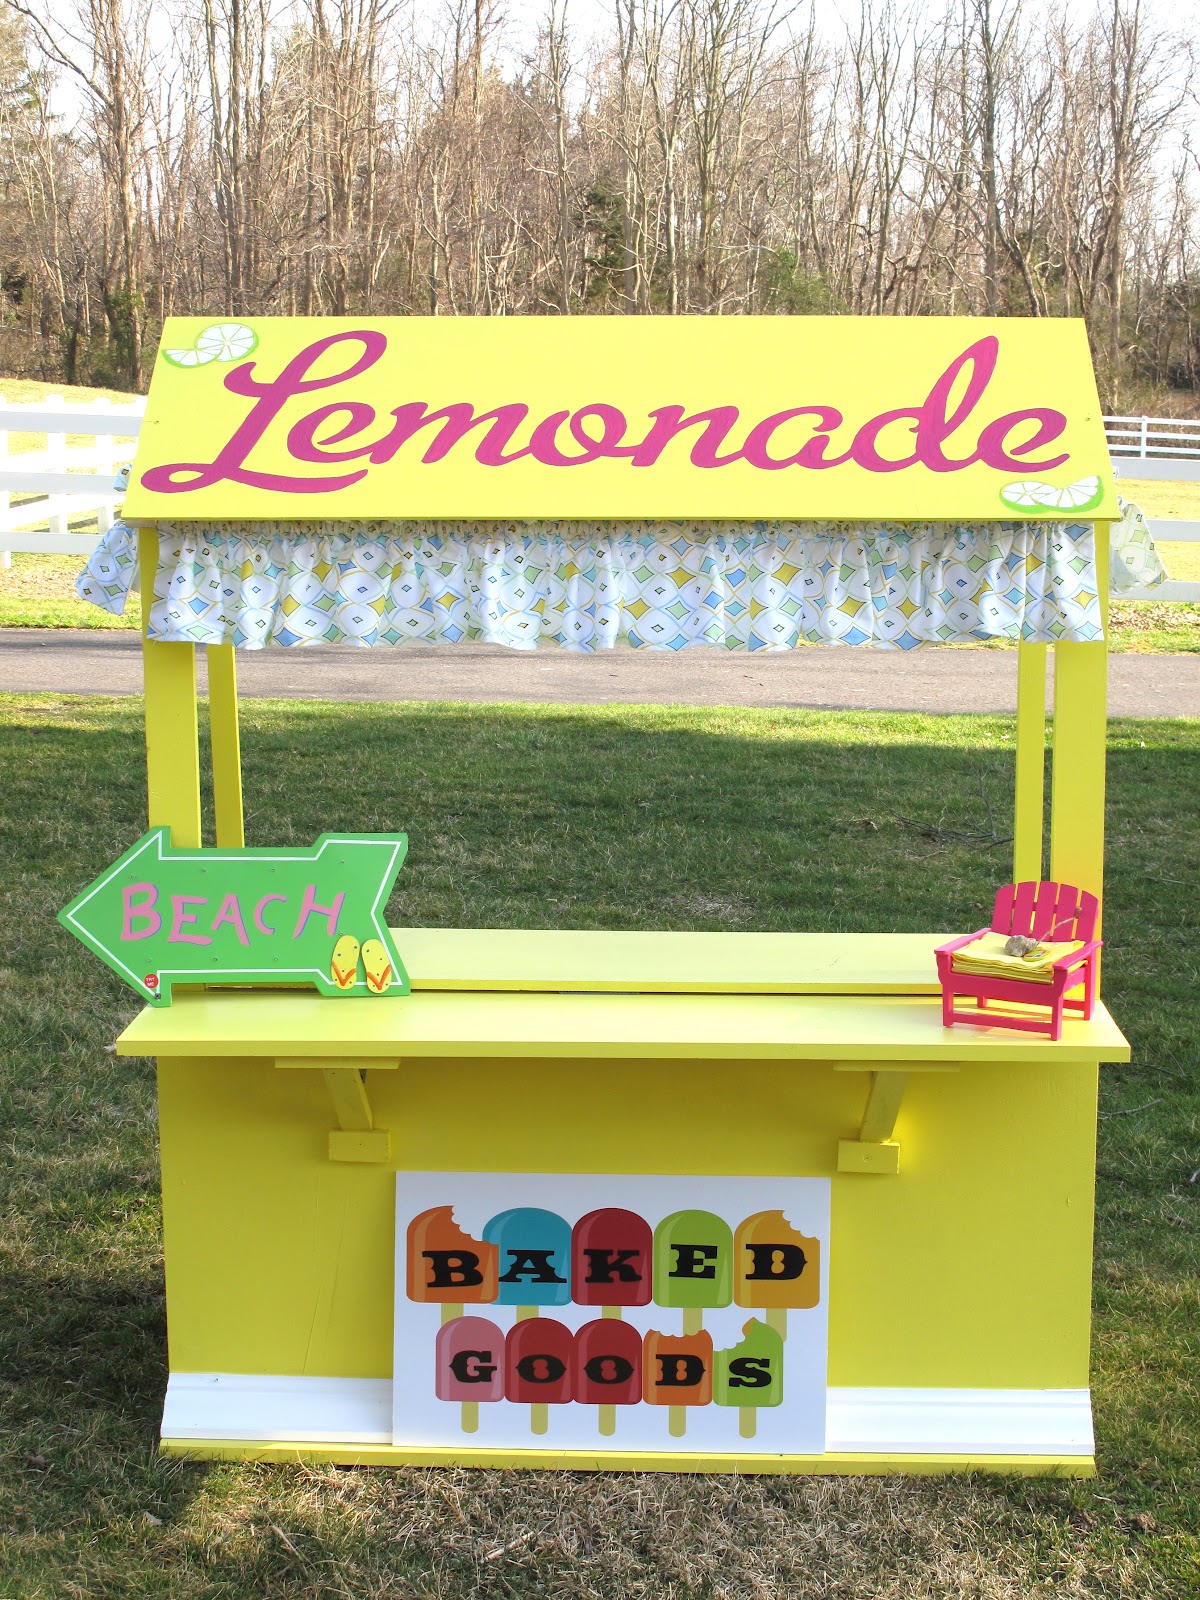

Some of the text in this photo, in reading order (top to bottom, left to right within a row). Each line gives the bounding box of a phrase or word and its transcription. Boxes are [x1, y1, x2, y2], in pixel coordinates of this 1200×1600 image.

[141, 330, 1070, 493] Lemonade
[120, 882, 345, 946] BEACH
[421, 1243, 808, 1288] BAKED
[449, 1350, 772, 1388] GOODS
